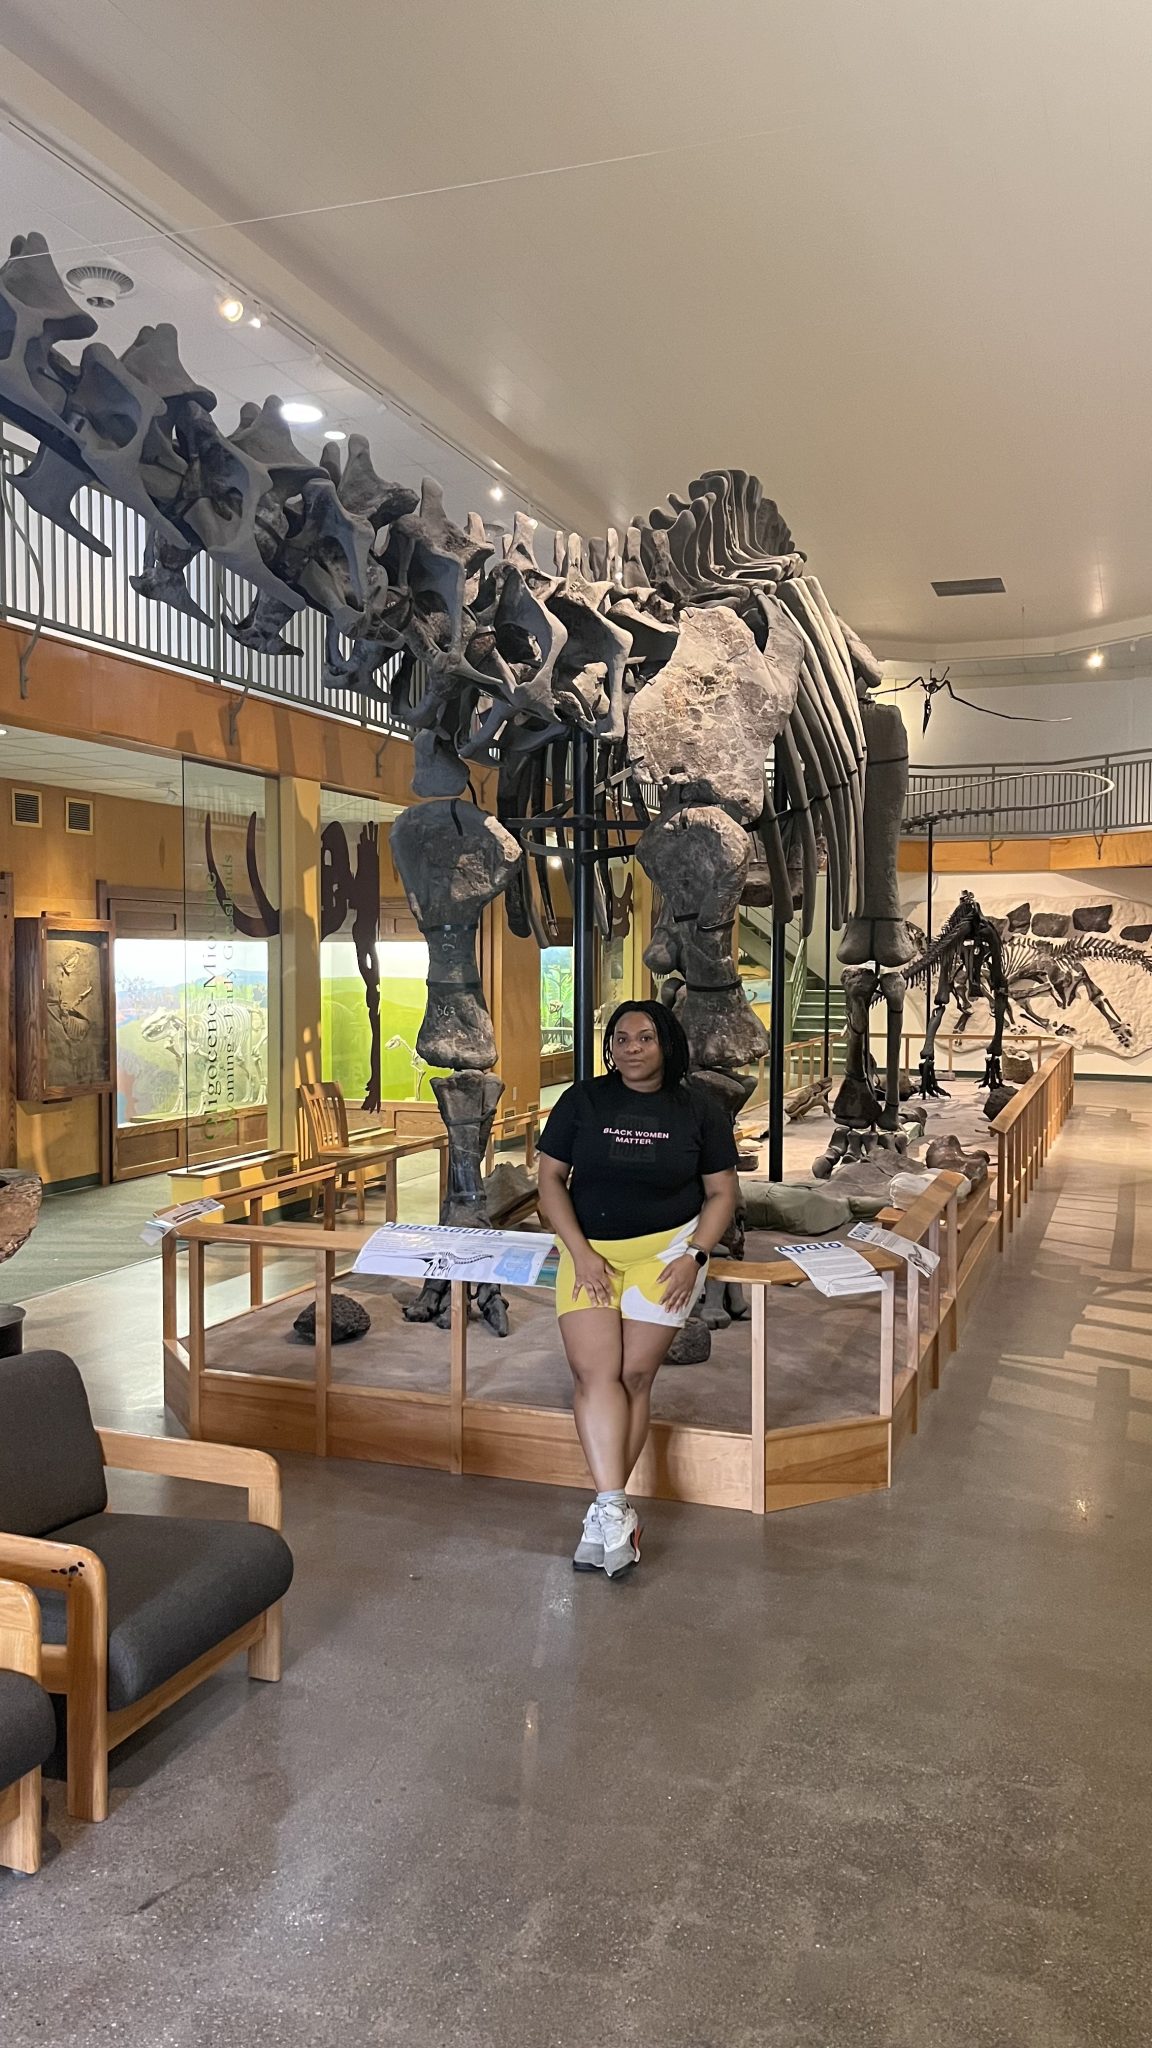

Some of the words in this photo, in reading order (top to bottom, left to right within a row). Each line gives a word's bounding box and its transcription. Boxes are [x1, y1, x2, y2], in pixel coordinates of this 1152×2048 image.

[603, 1127, 633, 1137] BLACK
[635, 1130, 670, 1140] WOMEN
[615, 1136, 654, 1146] MATTER.
[778, 1242, 842, 1254] Apato
